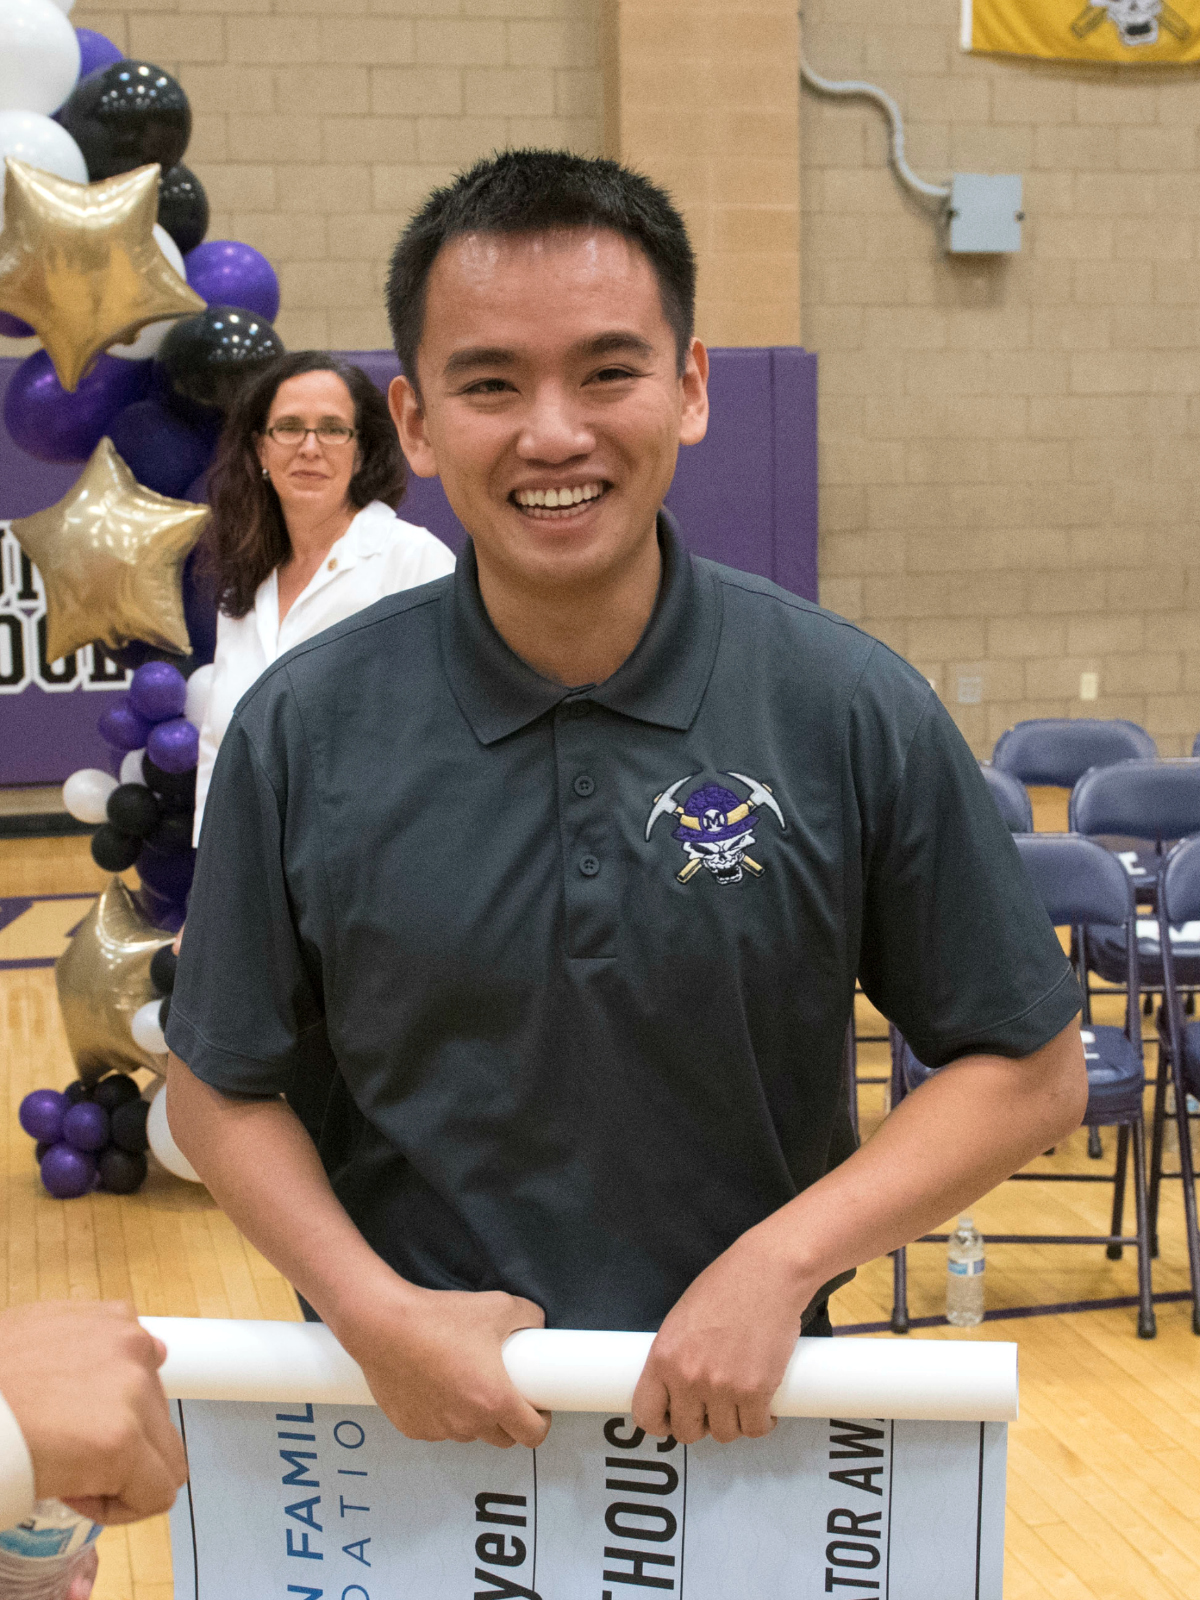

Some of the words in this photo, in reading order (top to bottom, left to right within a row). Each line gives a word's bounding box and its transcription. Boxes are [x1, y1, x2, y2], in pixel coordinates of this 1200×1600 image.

[703, 810, 726, 830] M
[827, 1418, 886, 1497] AW
[473, 1491, 543, 1600] yen
[601, 1417, 680, 1600] HOUS
[825, 1508, 883, 1600] TOR
